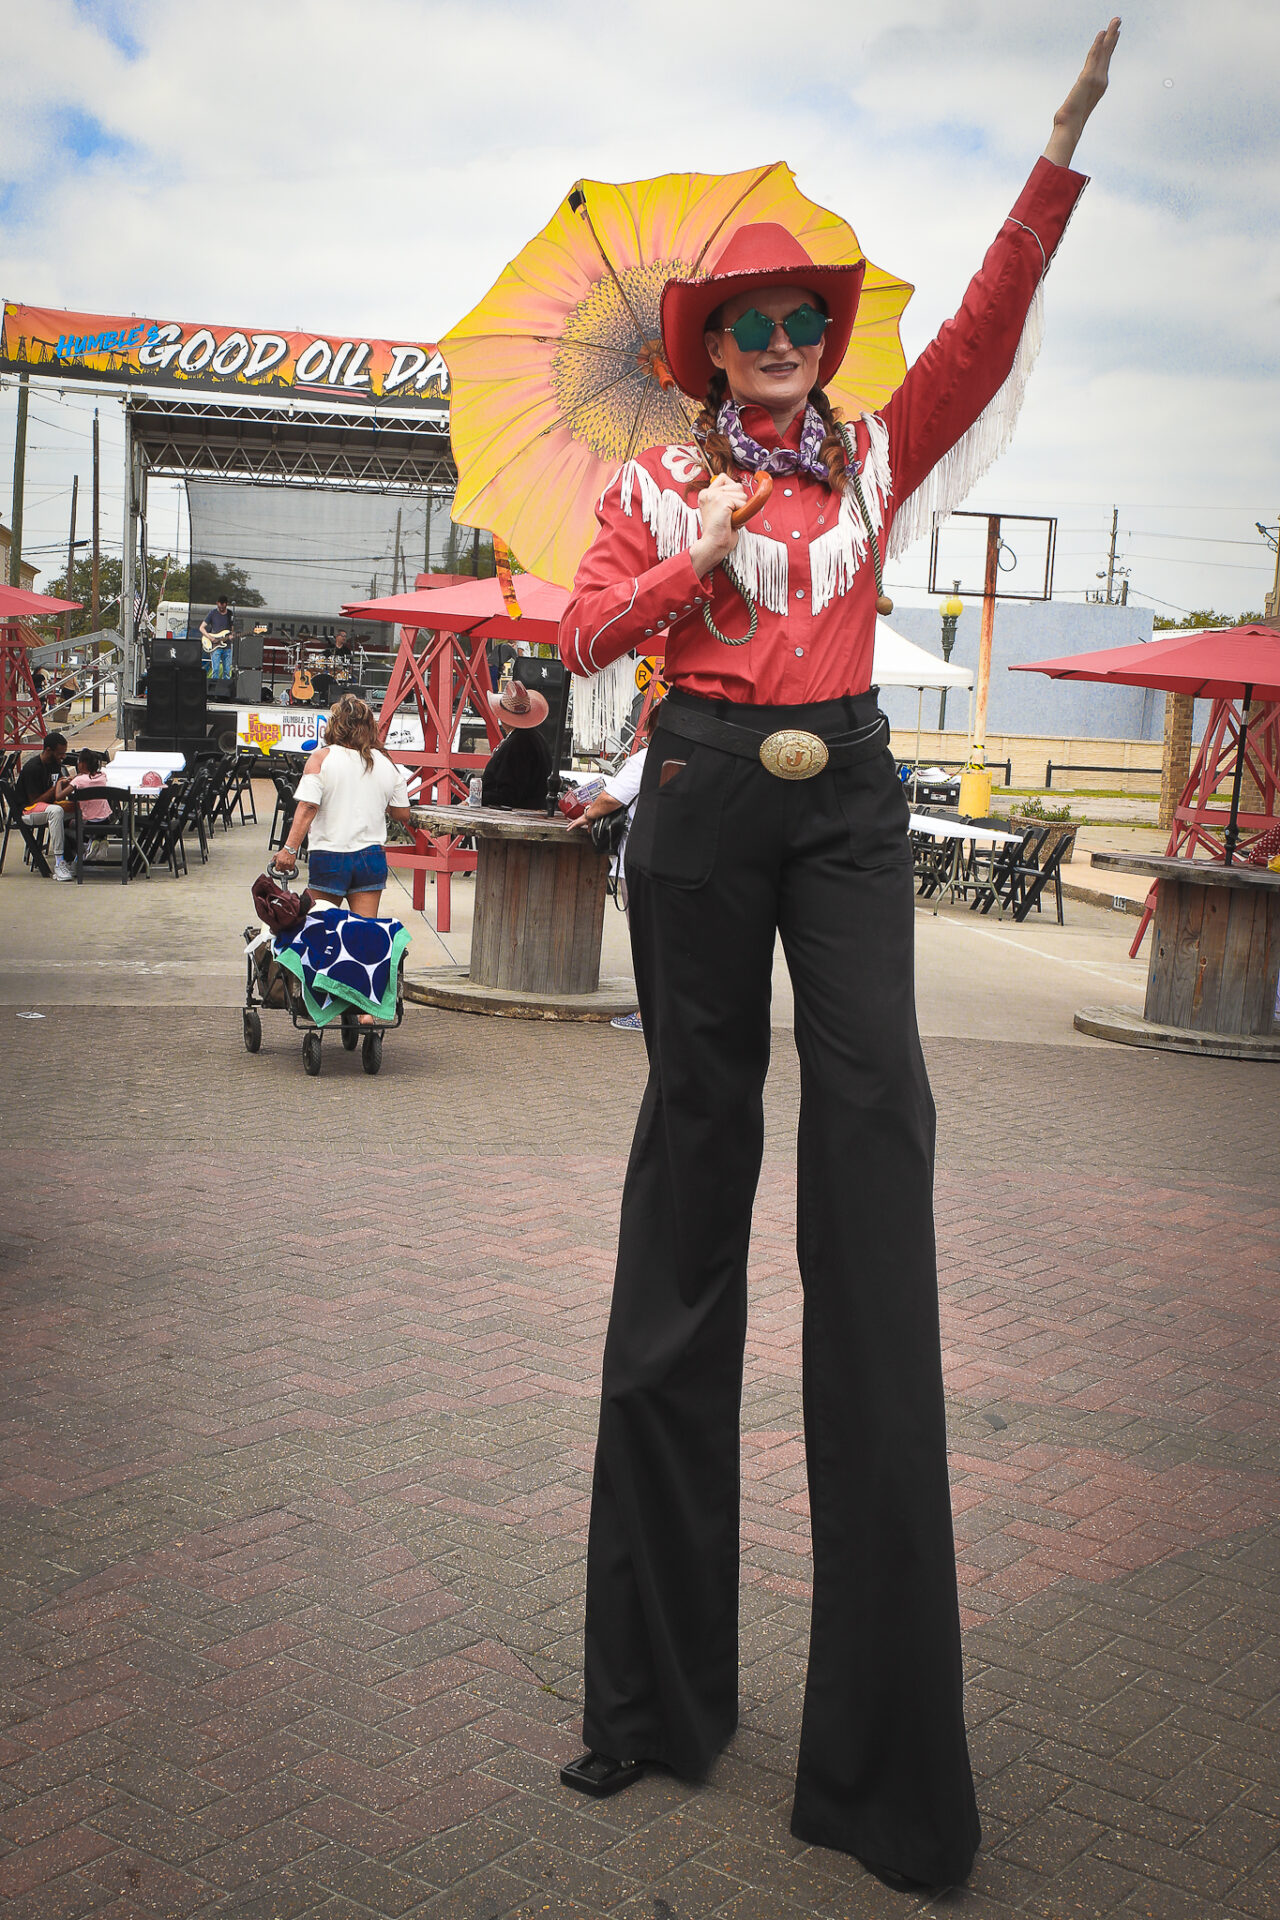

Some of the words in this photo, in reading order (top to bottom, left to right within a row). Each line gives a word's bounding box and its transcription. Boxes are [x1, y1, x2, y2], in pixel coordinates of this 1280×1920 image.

[55, 323, 160, 359] HUMBLE'S
[138, 322, 288, 379] GOOD
[295, 337, 371, 387] OIL
[638, 670, 647, 681] R
[307, 716, 315, 725] TX
[785, 748, 805, 767] J
